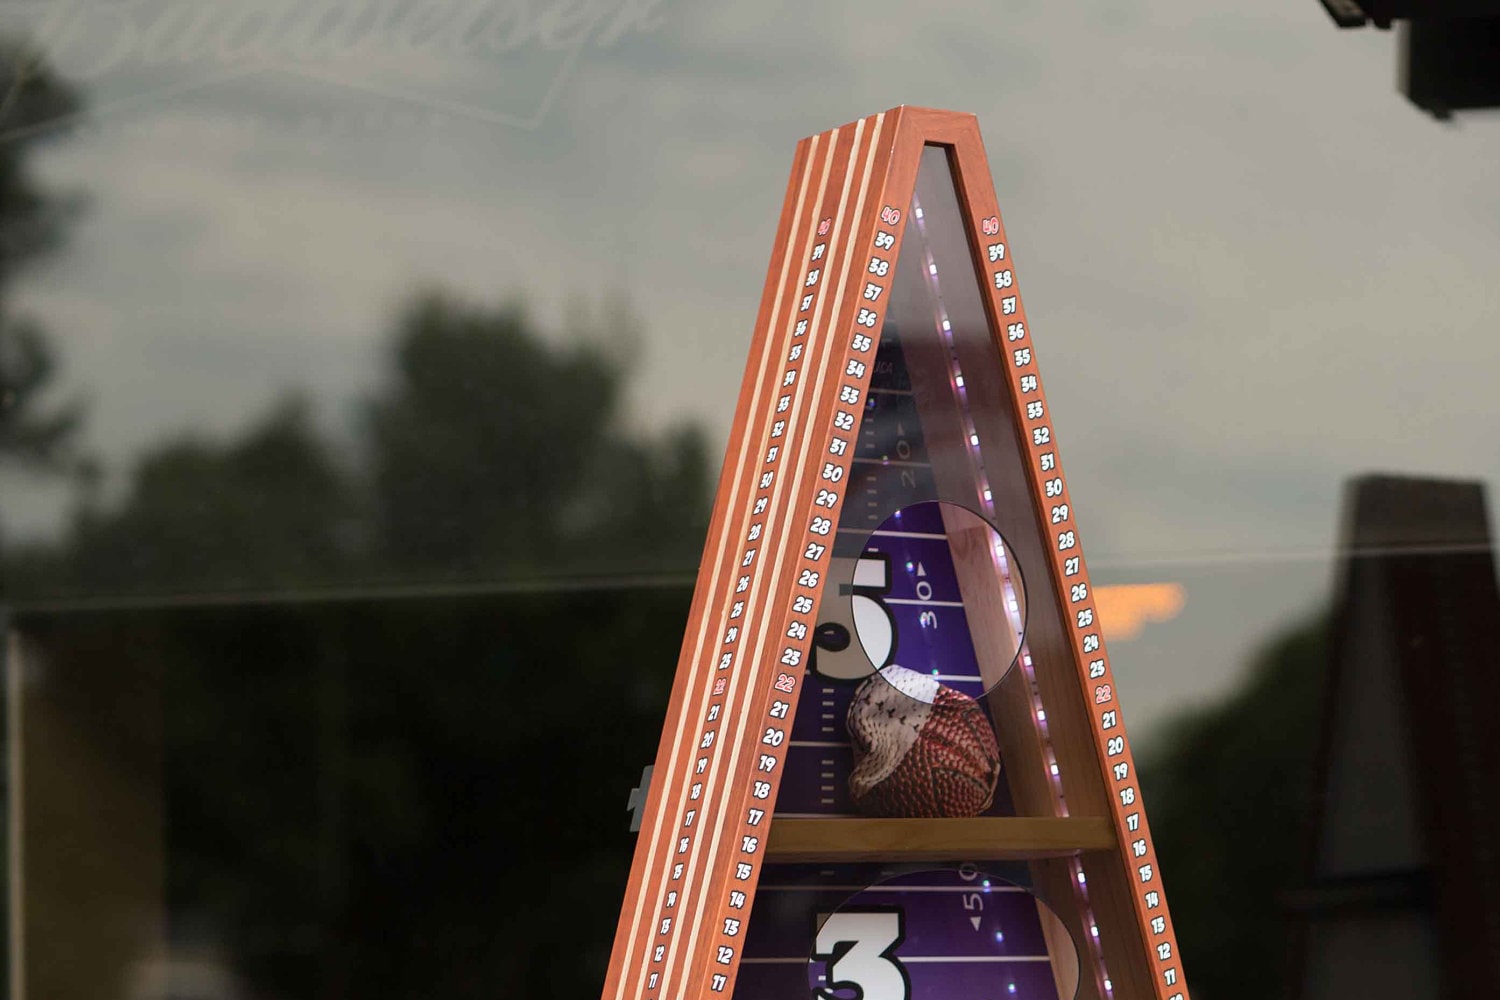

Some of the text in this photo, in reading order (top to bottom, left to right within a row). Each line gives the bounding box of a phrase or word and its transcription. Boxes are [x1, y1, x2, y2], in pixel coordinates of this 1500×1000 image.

[880, 205, 901, 226] 40
[981, 218, 1000, 237] 40
[874, 230, 896, 251] 39
[987, 242, 1006, 263] 39
[867, 256, 890, 278] 38
[993, 269, 1013, 290] 38
[862, 282, 884, 302] 37
[856, 308, 878, 328] 36
[1007, 322, 1026, 342] 36
[851, 333, 873, 353] 35
[1013, 347, 1032, 367] 35
[845, 358, 867, 379] 34
[1020, 374, 1038, 394] 34
[839, 384, 861, 405] 33
[1026, 400, 1045, 420] 33
[833, 410, 855, 432] 32
[1032, 426, 1051, 446] 32
[828, 437, 848, 457] 31
[1039, 452, 1056, 472] 31
[821, 462, 844, 483] 30
[1044, 477, 1064, 498] 30
[814, 489, 839, 509] 29
[1051, 503, 1069, 524] 29
[809, 516, 832, 536] 28
[1057, 530, 1076, 551] 28
[803, 542, 826, 562] 27
[797, 568, 820, 589] 26
[1070, 582, 1088, 603] 26
[791, 595, 814, 615] 25
[814, 554, 897, 683] 5
[1076, 608, 1094, 629] 25
[786, 620, 808, 641] 24
[1082, 634, 1100, 654] 24
[780, 647, 802, 667] 23
[1089, 659, 1107, 679] 23
[773, 672, 796, 694] 22
[1094, 684, 1112, 703] 22
[768, 700, 790, 720] 21
[1101, 710, 1117, 730] 21
[761, 727, 785, 748] 20
[1107, 735, 1125, 757] 20
[758, 754, 778, 773] 19
[1113, 761, 1129, 781] 19
[752, 780, 772, 800] 18
[1119, 786, 1136, 806] 18
[747, 808, 765, 827] 17
[740, 835, 759, 854] 16
[1132, 838, 1148, 858] 16
[735, 862, 753, 881] 15
[1138, 863, 1153, 883] 15
[728, 890, 747, 910] 14
[1144, 891, 1160, 909] 14
[722, 918, 741, 937] 13
[1150, 915, 1166, 935] 13
[716, 945, 734, 965] 12
[1156, 941, 1172, 961] 12
[711, 973, 728, 992] 11
[1163, 967, 1177, 986] 11
